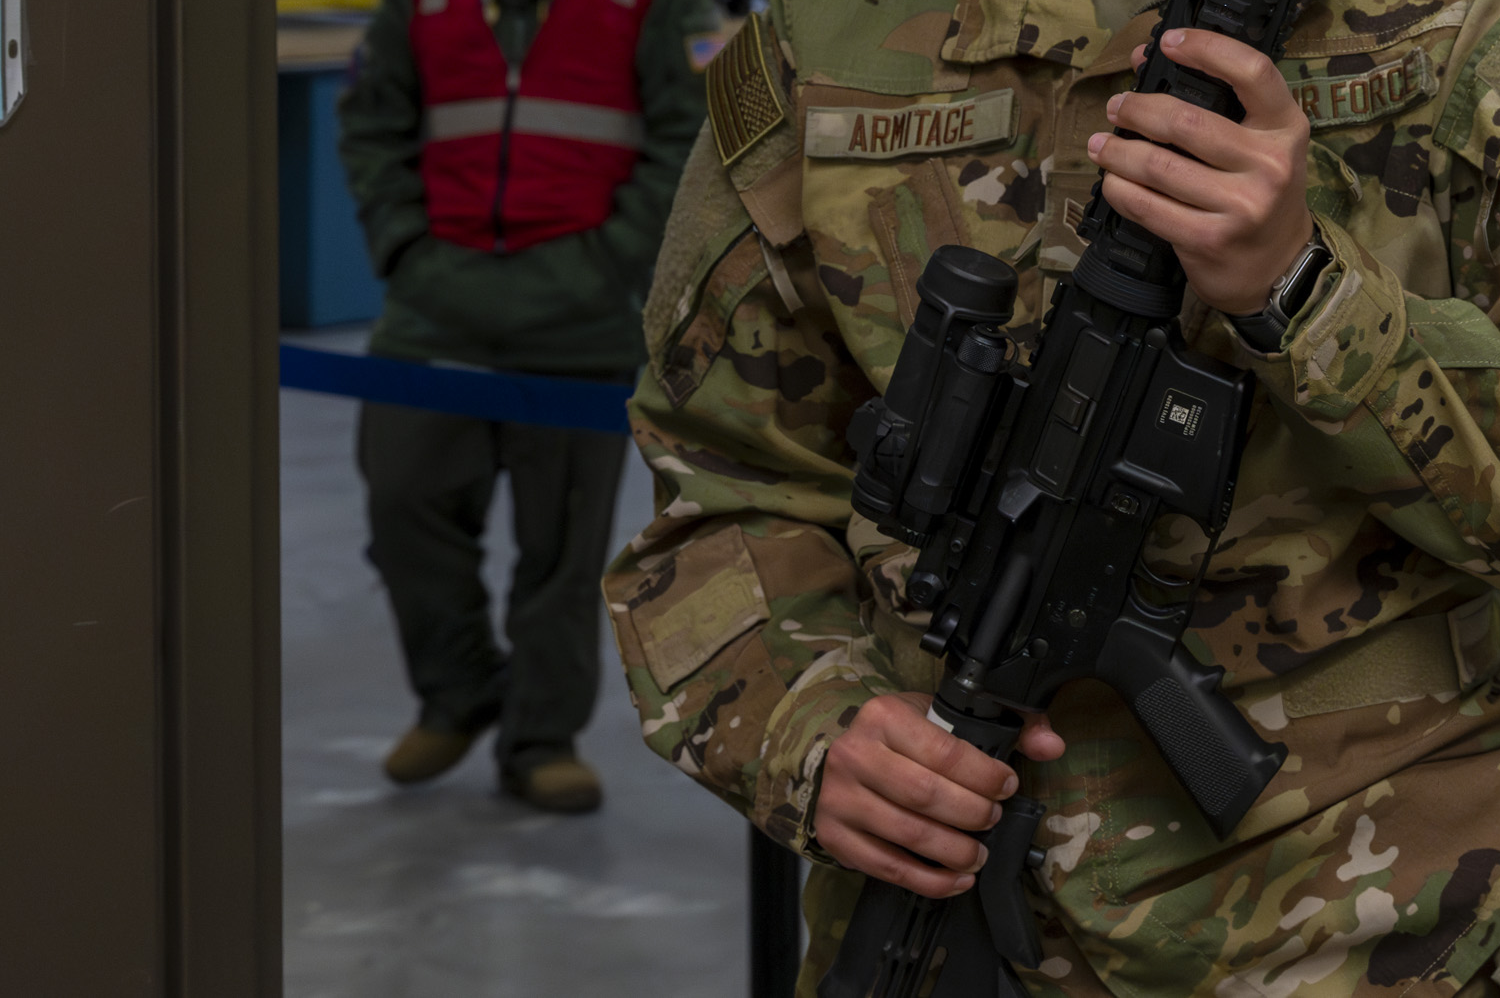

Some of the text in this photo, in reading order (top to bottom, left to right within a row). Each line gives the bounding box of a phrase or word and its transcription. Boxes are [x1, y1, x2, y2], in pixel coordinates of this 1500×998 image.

[1292, 55, 1418, 120] IR FORCE
[849, 104, 975, 153] ARMITAGE
